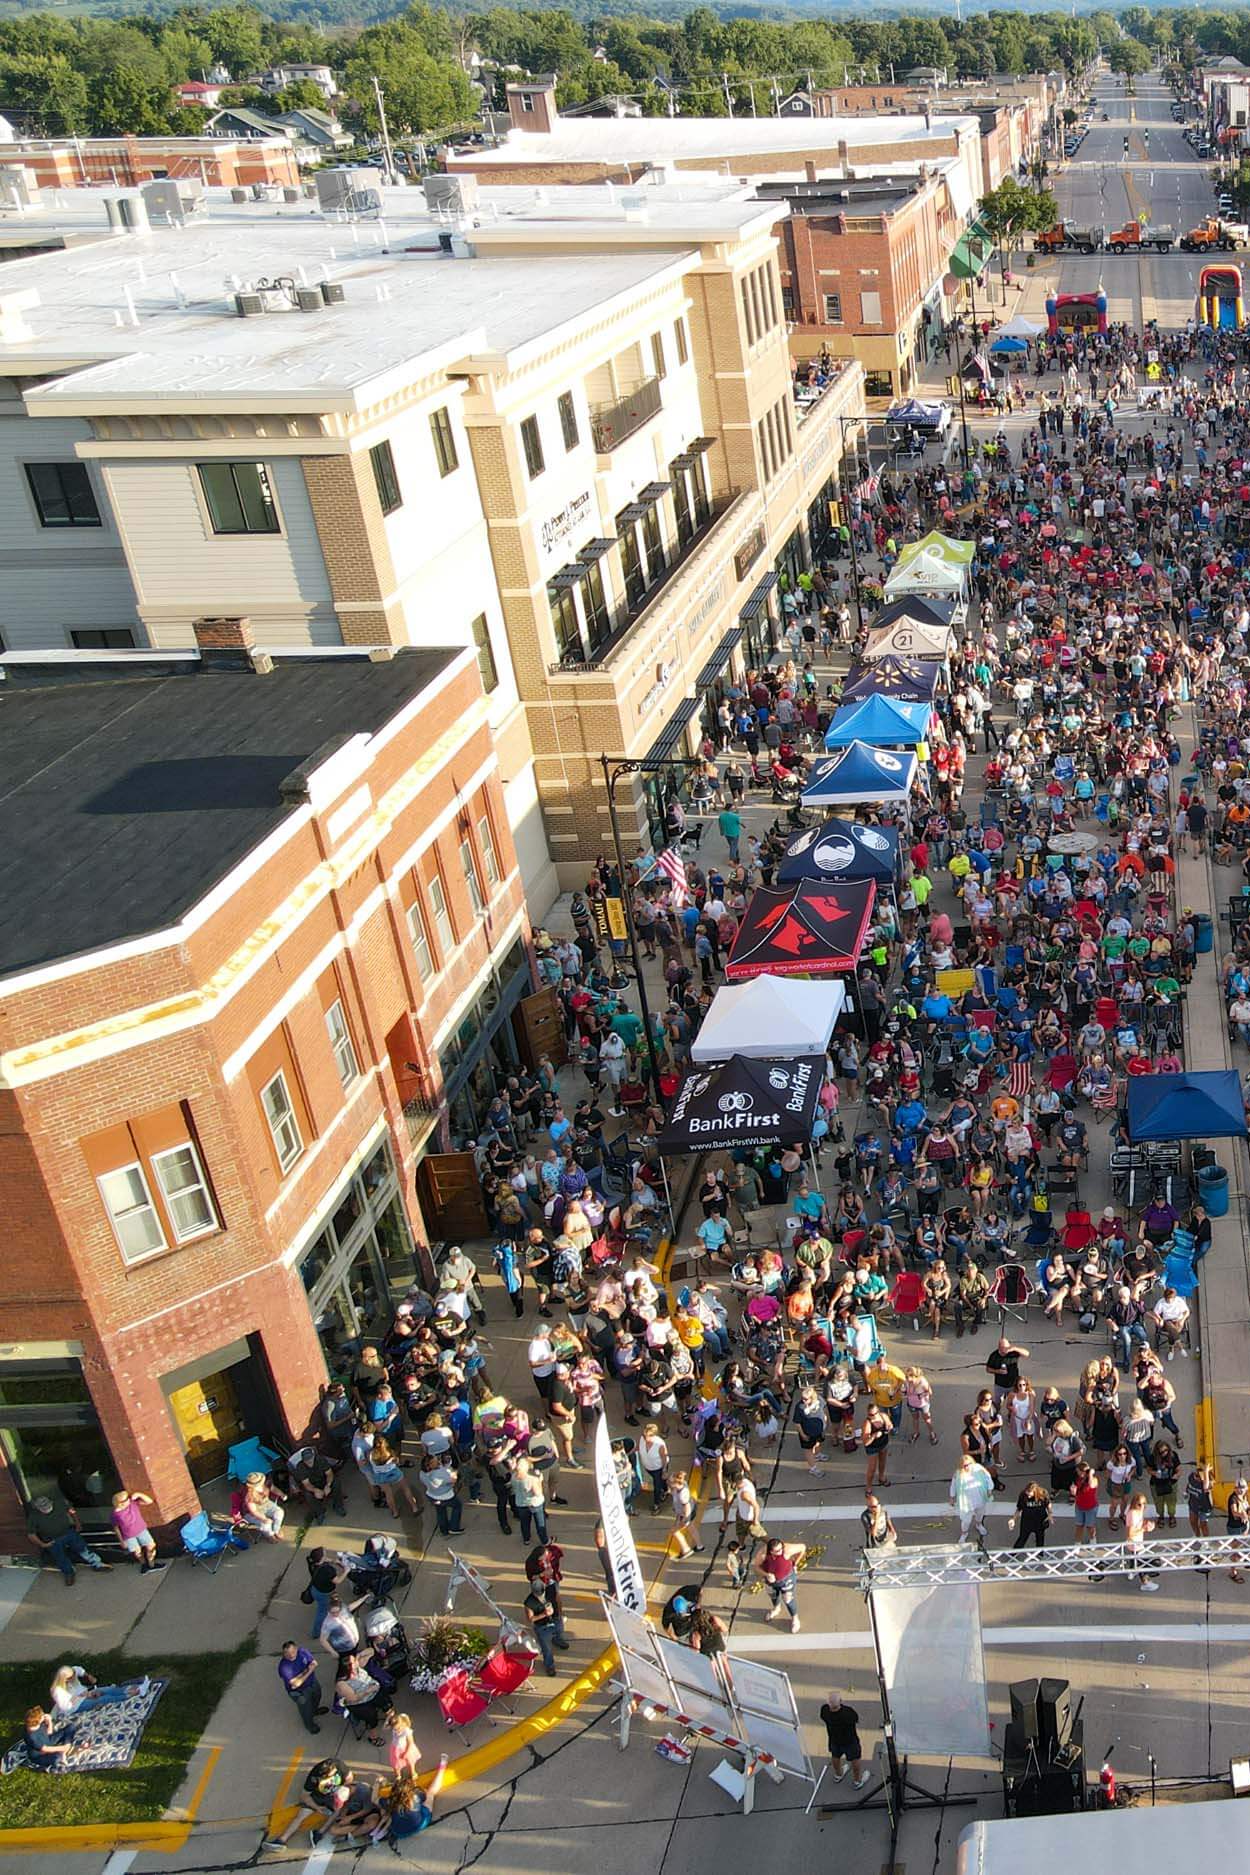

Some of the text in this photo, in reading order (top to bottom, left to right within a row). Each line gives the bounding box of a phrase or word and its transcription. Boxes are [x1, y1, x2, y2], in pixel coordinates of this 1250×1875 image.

[594, 903, 608, 936] TOMAH
[786, 1063, 812, 1112] BankFirst
[689, 1113, 780, 1133] BankFirst
